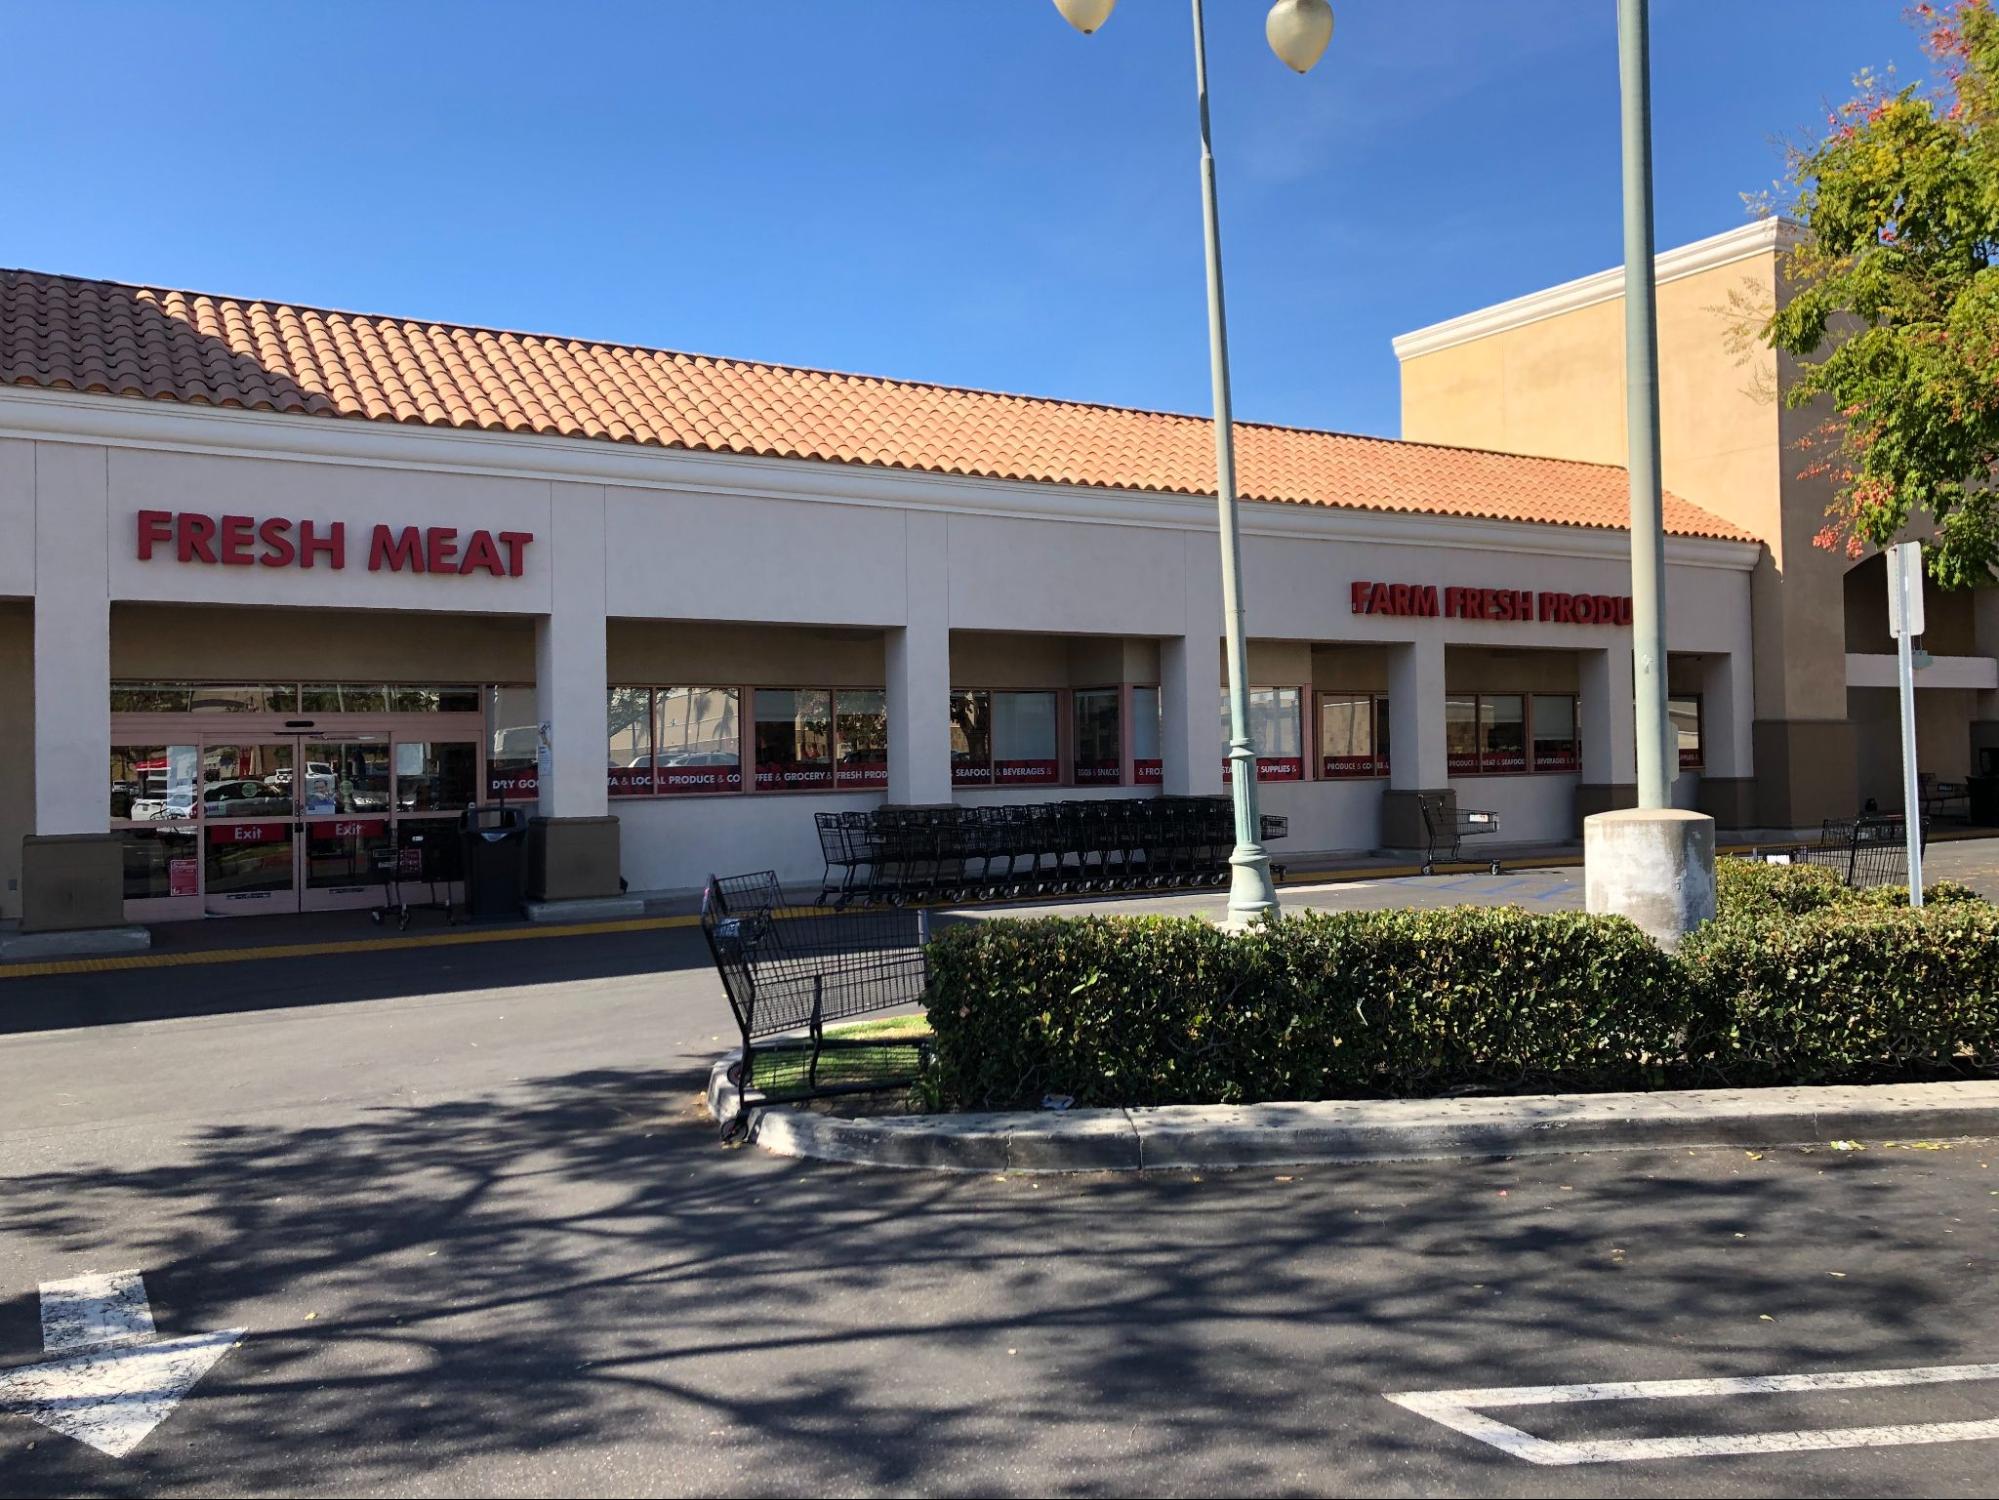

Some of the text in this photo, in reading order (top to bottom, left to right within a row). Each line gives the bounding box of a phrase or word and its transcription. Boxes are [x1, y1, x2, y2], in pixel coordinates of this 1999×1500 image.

[138, 510, 534, 577] FRESH MEAT
[1351, 582, 1439, 616] FARM
[1445, 587, 1533, 621] FRESH
[1002, 767, 1046, 777] BEVERAGES
[1260, 765, 1291, 773] SUPPLIES
[669, 774, 715, 784] PRODUCE
[784, 771, 826, 782] GROCERY
[836, 770, 862, 780] FRESH
[492, 778, 540, 789] DRY GO
[234, 826, 262, 840] Exit
[335, 822, 361, 836] Exit
